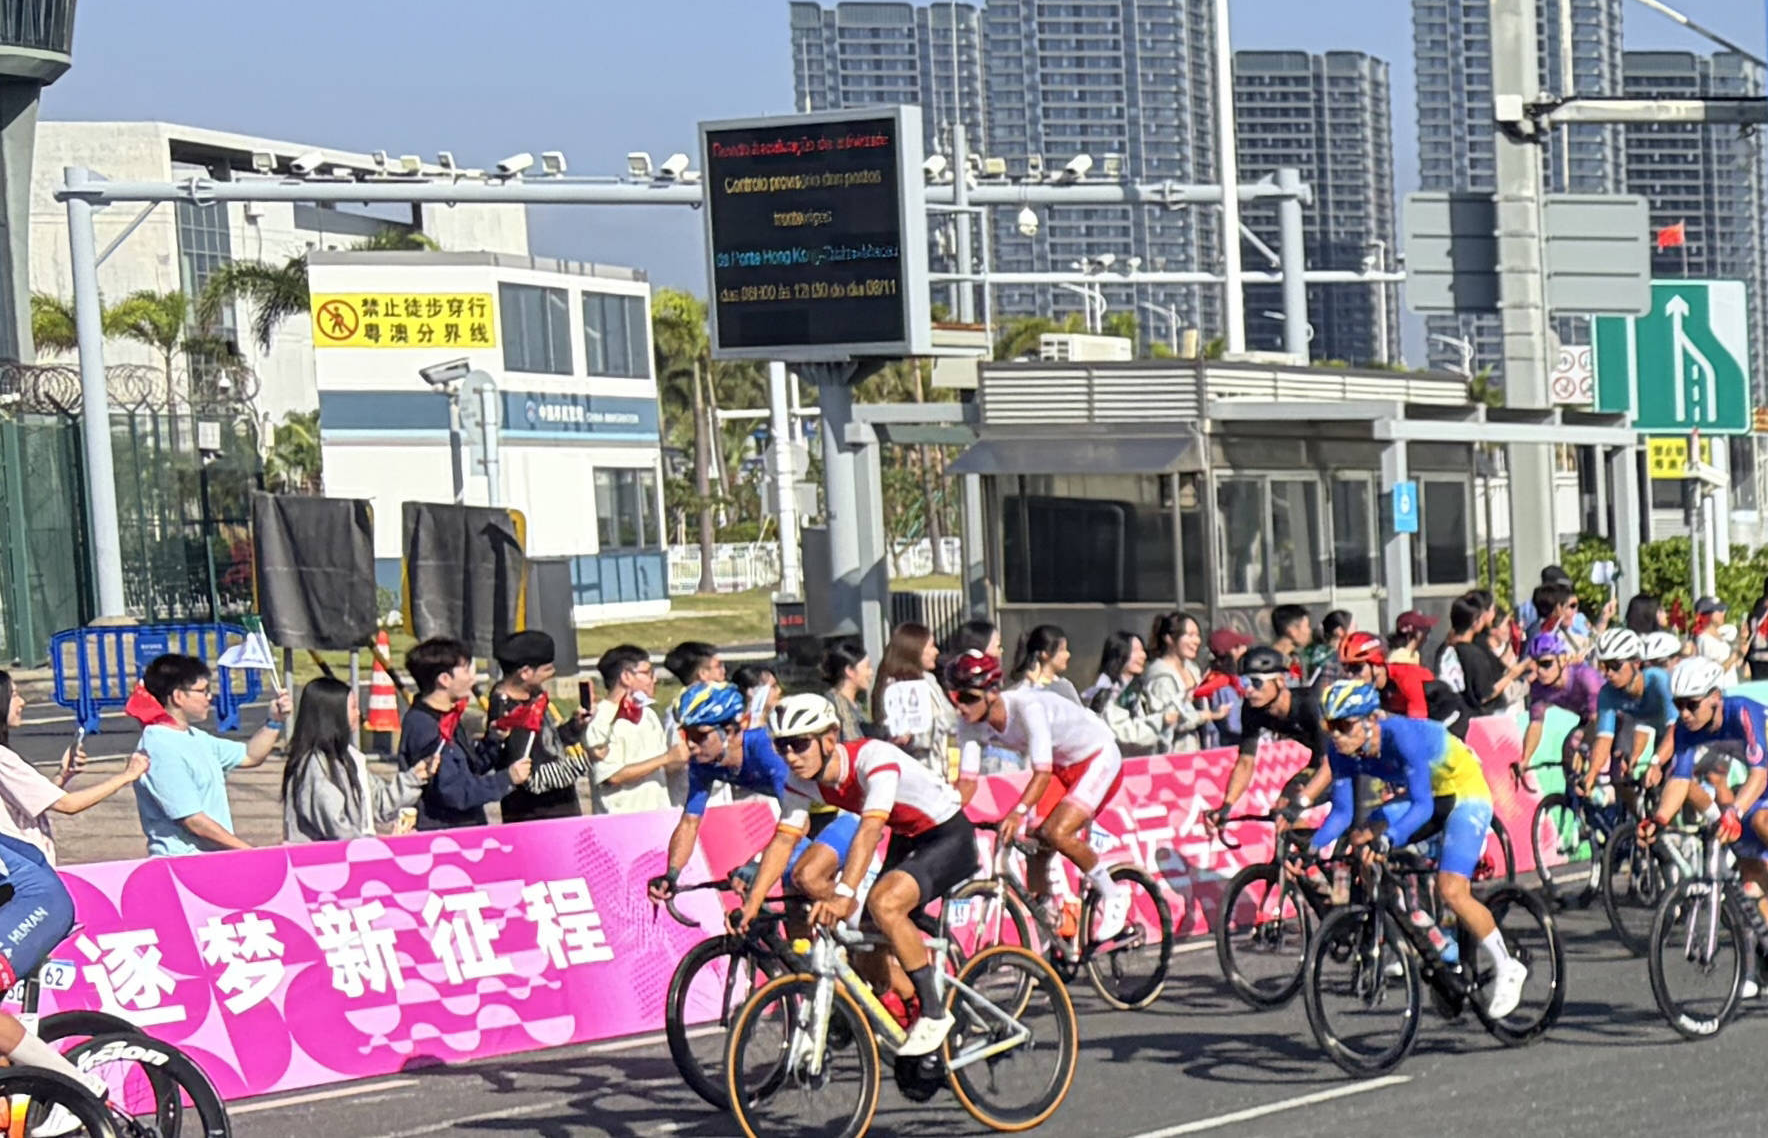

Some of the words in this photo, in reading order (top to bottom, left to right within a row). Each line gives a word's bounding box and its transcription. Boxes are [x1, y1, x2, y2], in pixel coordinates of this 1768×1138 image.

[361, 296, 487, 319] 禁止徒步穿行
[363, 322, 490, 344] 粤澳分界线
[73, 876, 616, 1028] 逐梦新征程
[44, 966, 64, 987] 62
